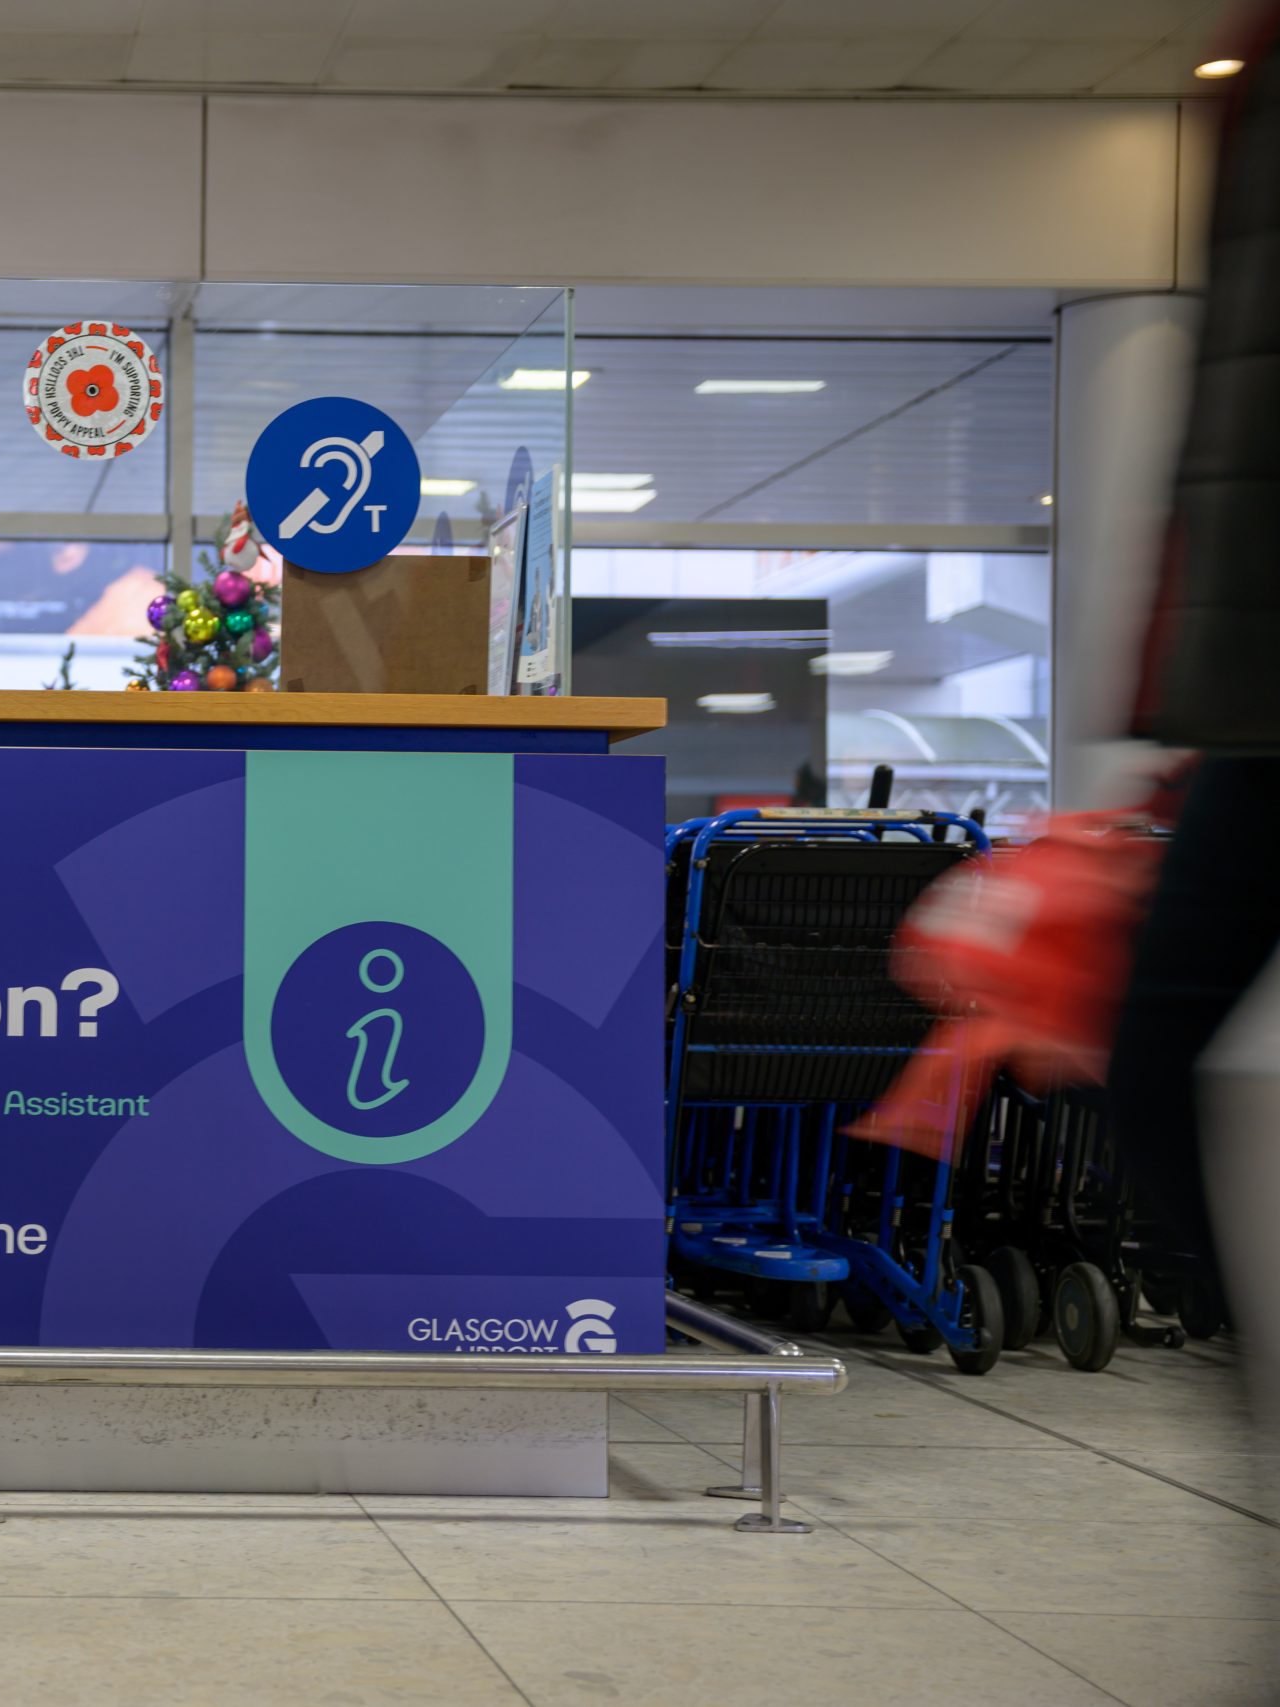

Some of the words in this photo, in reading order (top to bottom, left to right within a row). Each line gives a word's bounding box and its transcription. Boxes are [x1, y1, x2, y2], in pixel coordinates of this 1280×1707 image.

[65, 345, 85, 361] THE
[45, 356, 69, 400] SCOTTISH
[109, 350, 124, 364] I'M
[122, 362, 141, 418] SUPPORTING
[47, 401, 72, 429] POPPY
[70, 424, 106, 439] APPEAL
[363, 504, 388, 533] T
[3, 1090, 150, 1117] Assistant
[407, 1317, 559, 1343] GLASGOW
